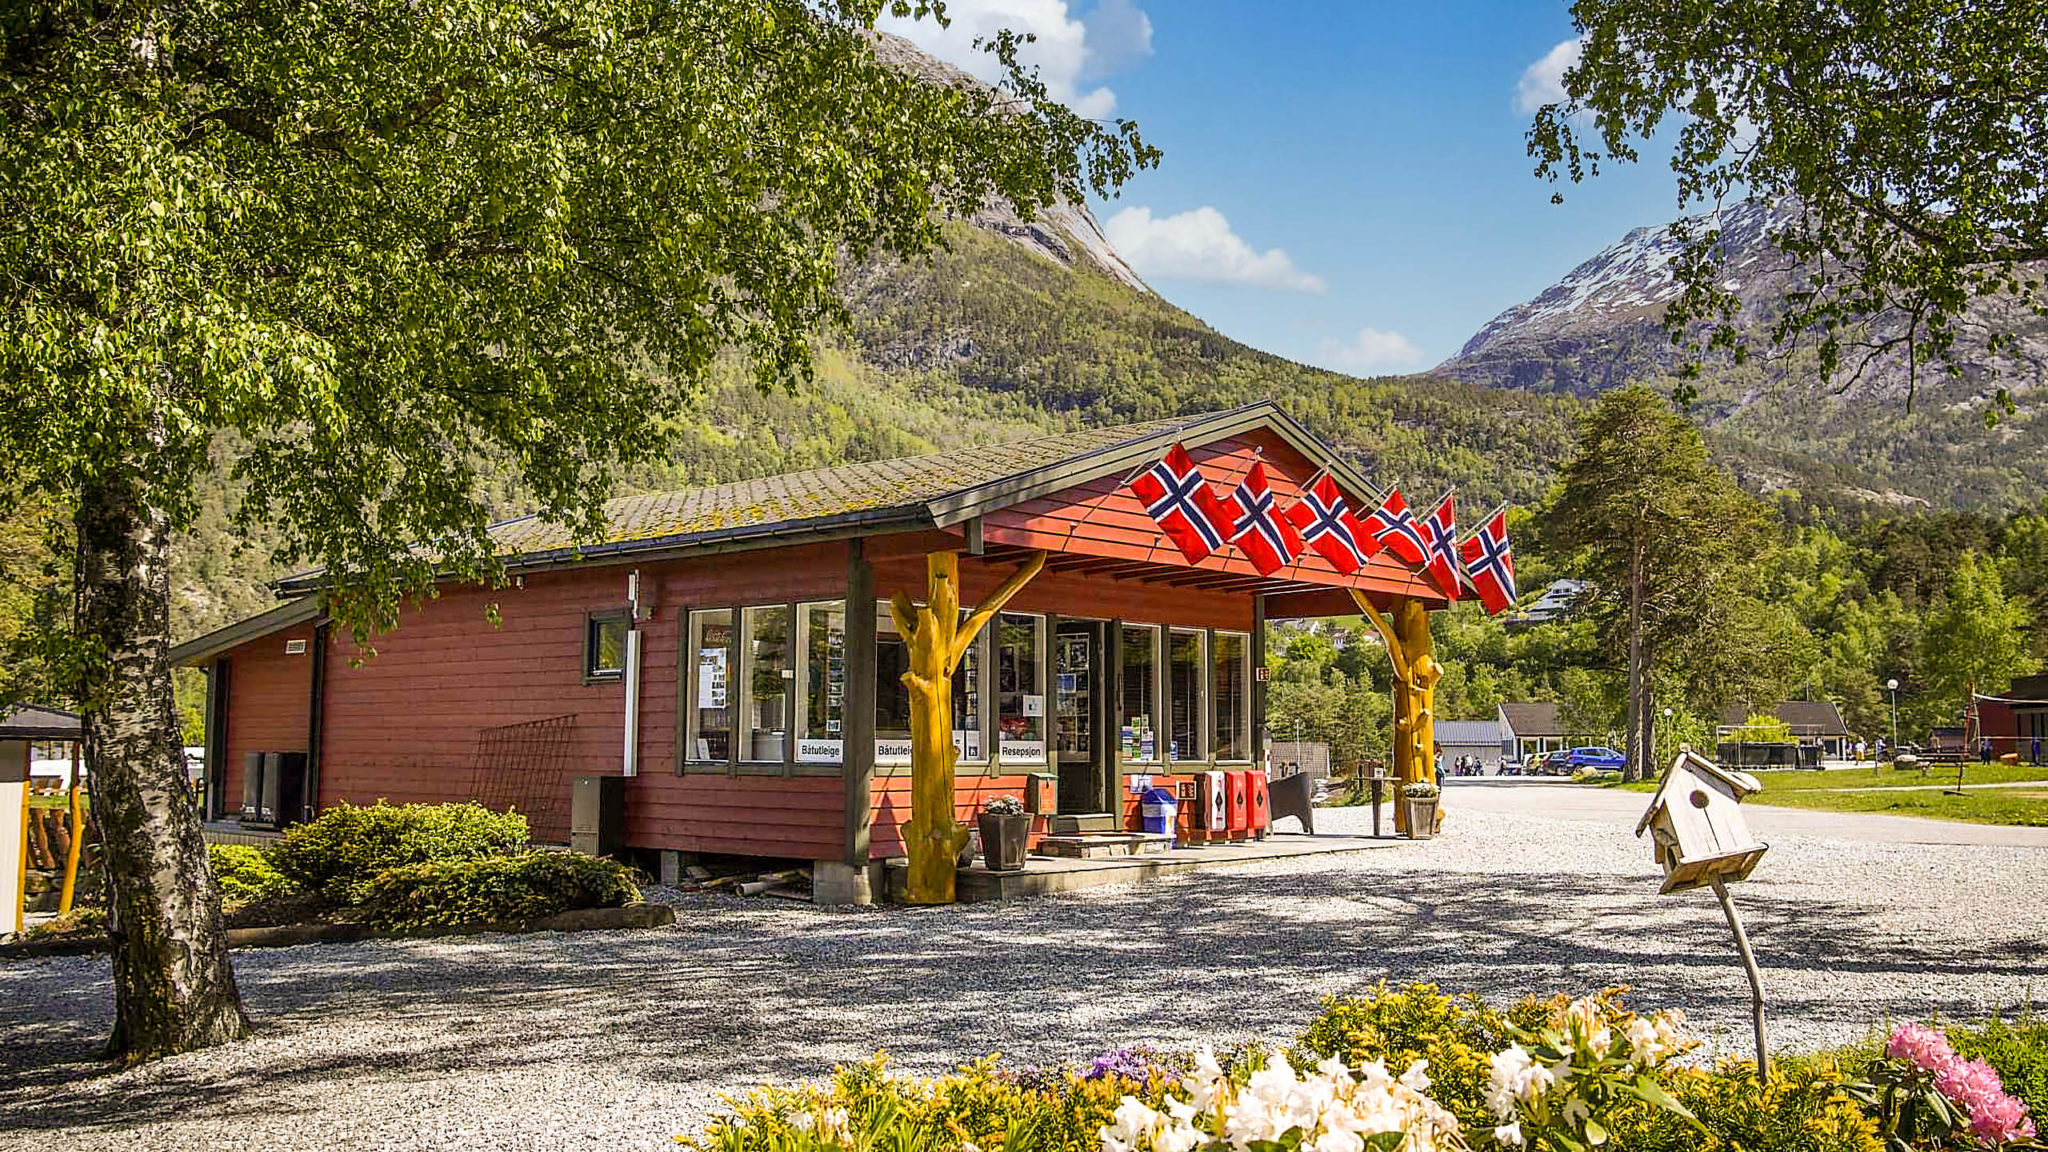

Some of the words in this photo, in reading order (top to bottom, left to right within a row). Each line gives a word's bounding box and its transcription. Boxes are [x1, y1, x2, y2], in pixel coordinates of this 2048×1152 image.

[801, 745, 840, 758] Båtutleige
[878, 745, 912, 756] Båtutlei
[1002, 746, 1041, 757] Resepsjon
